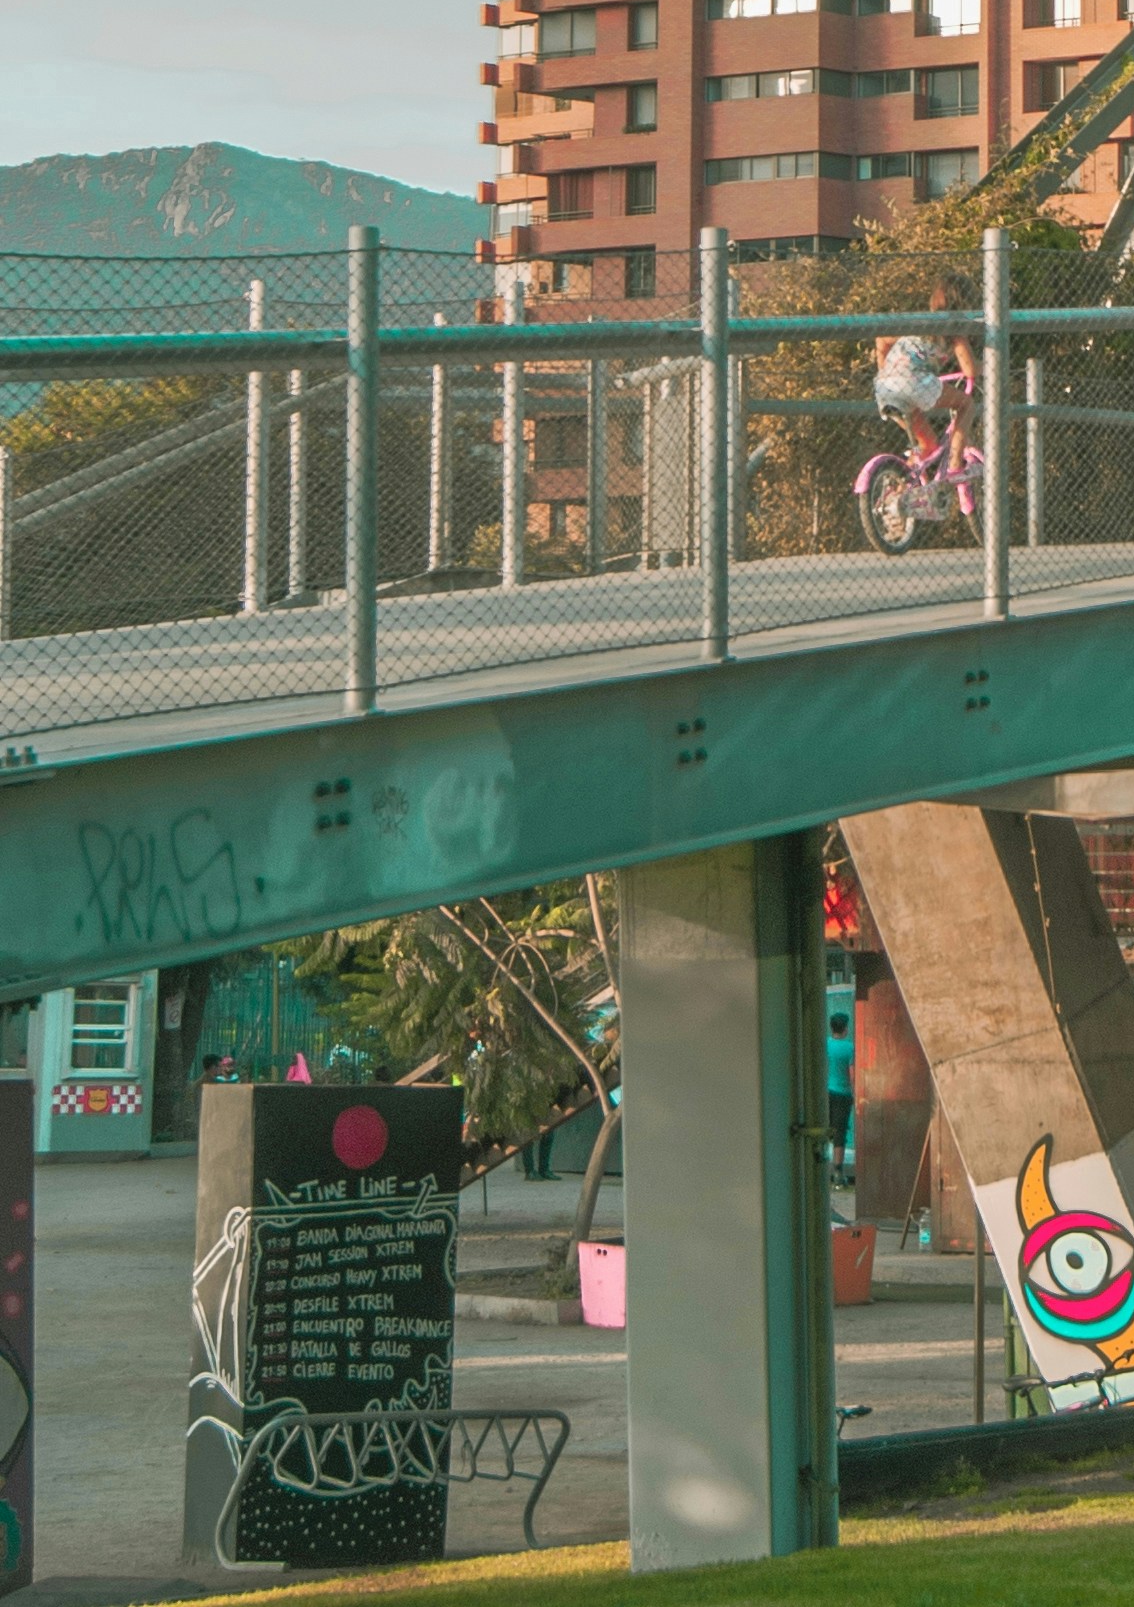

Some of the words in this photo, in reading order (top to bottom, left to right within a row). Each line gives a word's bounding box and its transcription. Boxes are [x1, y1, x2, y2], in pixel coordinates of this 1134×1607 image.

[297, 1227, 339, 1246] BANDA
[295, 1252, 322, 1270] JAM
[328, 1245, 368, 1263] SESSION
[376, 1241, 414, 1257] XTREM
[290, 1272, 341, 1289] CONCURSO
[382, 1264, 422, 1281] XTREM
[293, 1296, 339, 1314] DESFILE
[348, 1294, 394, 1311] XTREM
[293, 1317, 364, 1337] ENCUENTRO
[374, 1317, 451, 1338] BREAKDANCE
[290, 1341, 338, 1358] BATALLA
[349, 1342, 361, 1357] DE
[371, 1343, 411, 1358] GALLOS
[292, 1361, 336, 1378] CIERRE
[348, 1364, 394, 1380] EVENTO
